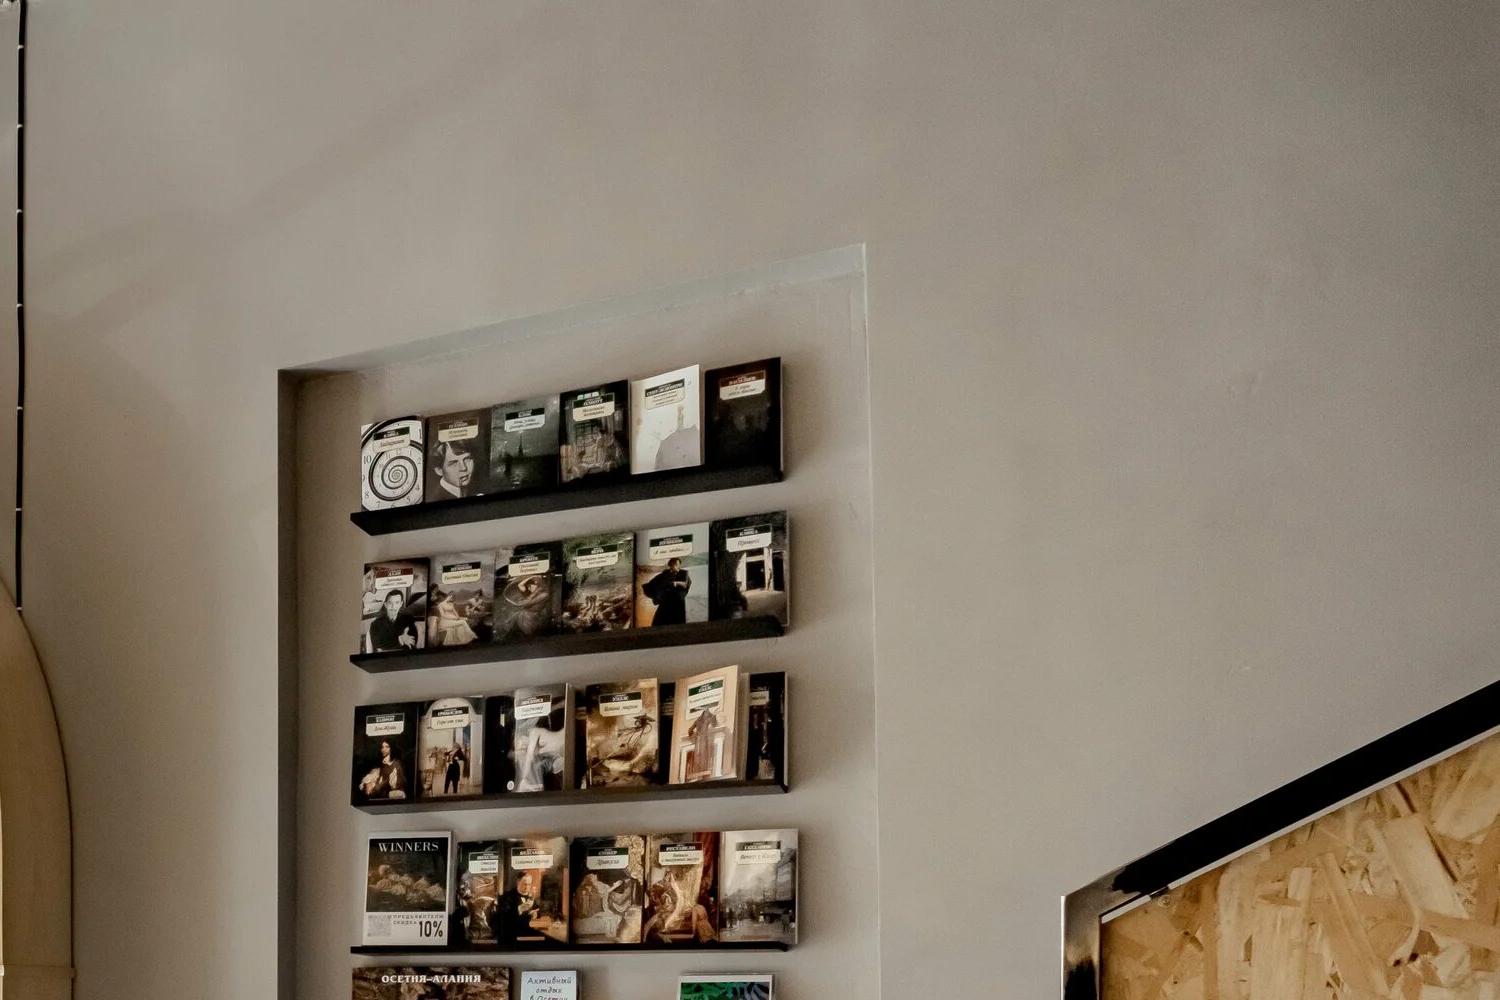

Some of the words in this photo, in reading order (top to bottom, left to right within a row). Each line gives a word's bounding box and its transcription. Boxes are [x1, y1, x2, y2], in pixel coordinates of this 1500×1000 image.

[378, 841, 439, 852] WINNERS
[418, 920, 443, 938] 10%
[527, 976, 572, 985] Активный
[535, 986, 562, 994] отдых
